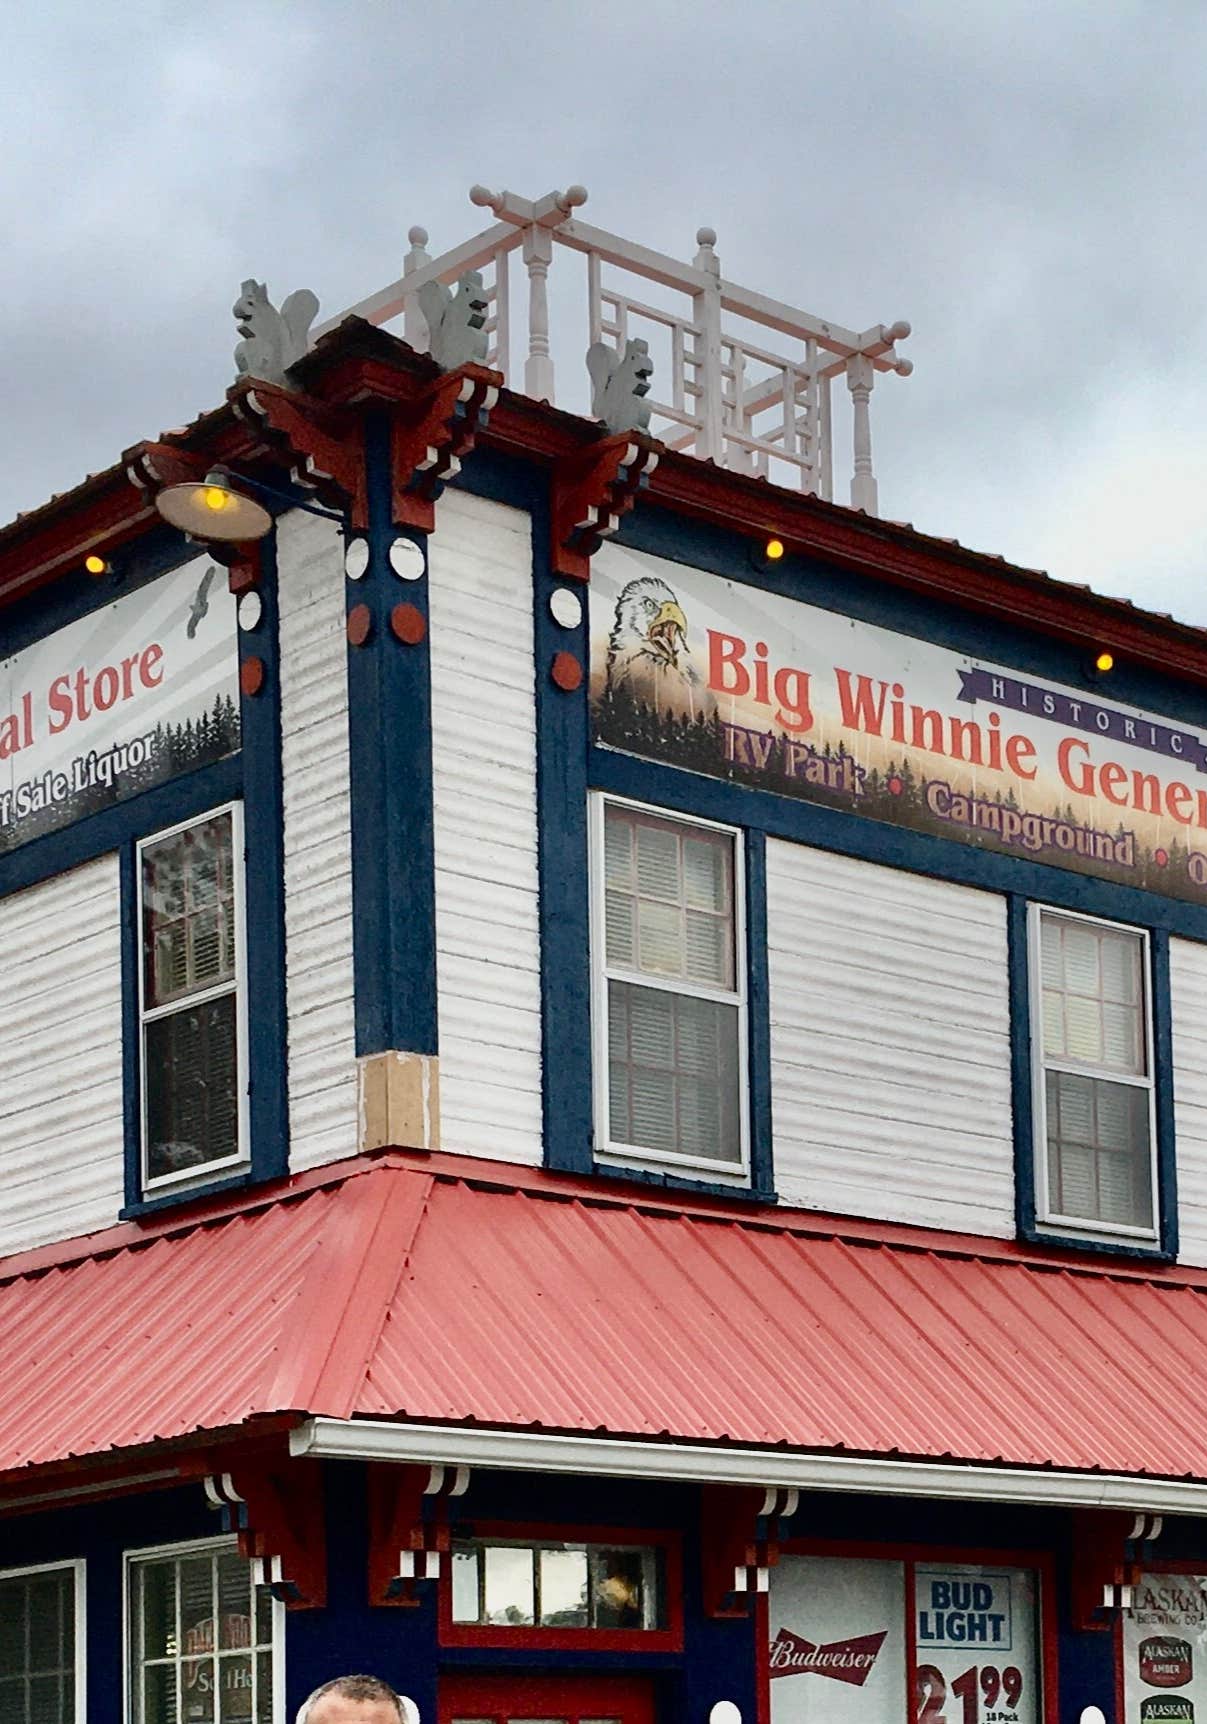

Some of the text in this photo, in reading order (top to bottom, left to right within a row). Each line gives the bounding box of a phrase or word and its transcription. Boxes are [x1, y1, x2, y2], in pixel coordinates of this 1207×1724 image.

[48, 643, 164, 735] Store
[706, 628, 814, 733] Big
[834, 667, 1037, 781] Winnie
[992, 680, 1183, 754] HISTORIC
[16, 773, 68, 818] Sale
[74, 735, 155, 793] Liquor
[724, 727, 774, 769] RV
[785, 743, 866, 796] Park
[927, 784, 1134, 866] Campground
[931, 1581, 993, 1611] BUD
[920, 1611, 1005, 1642] LIGHT
[769, 1640, 876, 1669] Budweiser
[1142, 1646, 1189, 1664] ALASKAN
[1152, 1664, 1180, 1674] AMBER
[1145, 1704, 1191, 1720] ALASKAN
